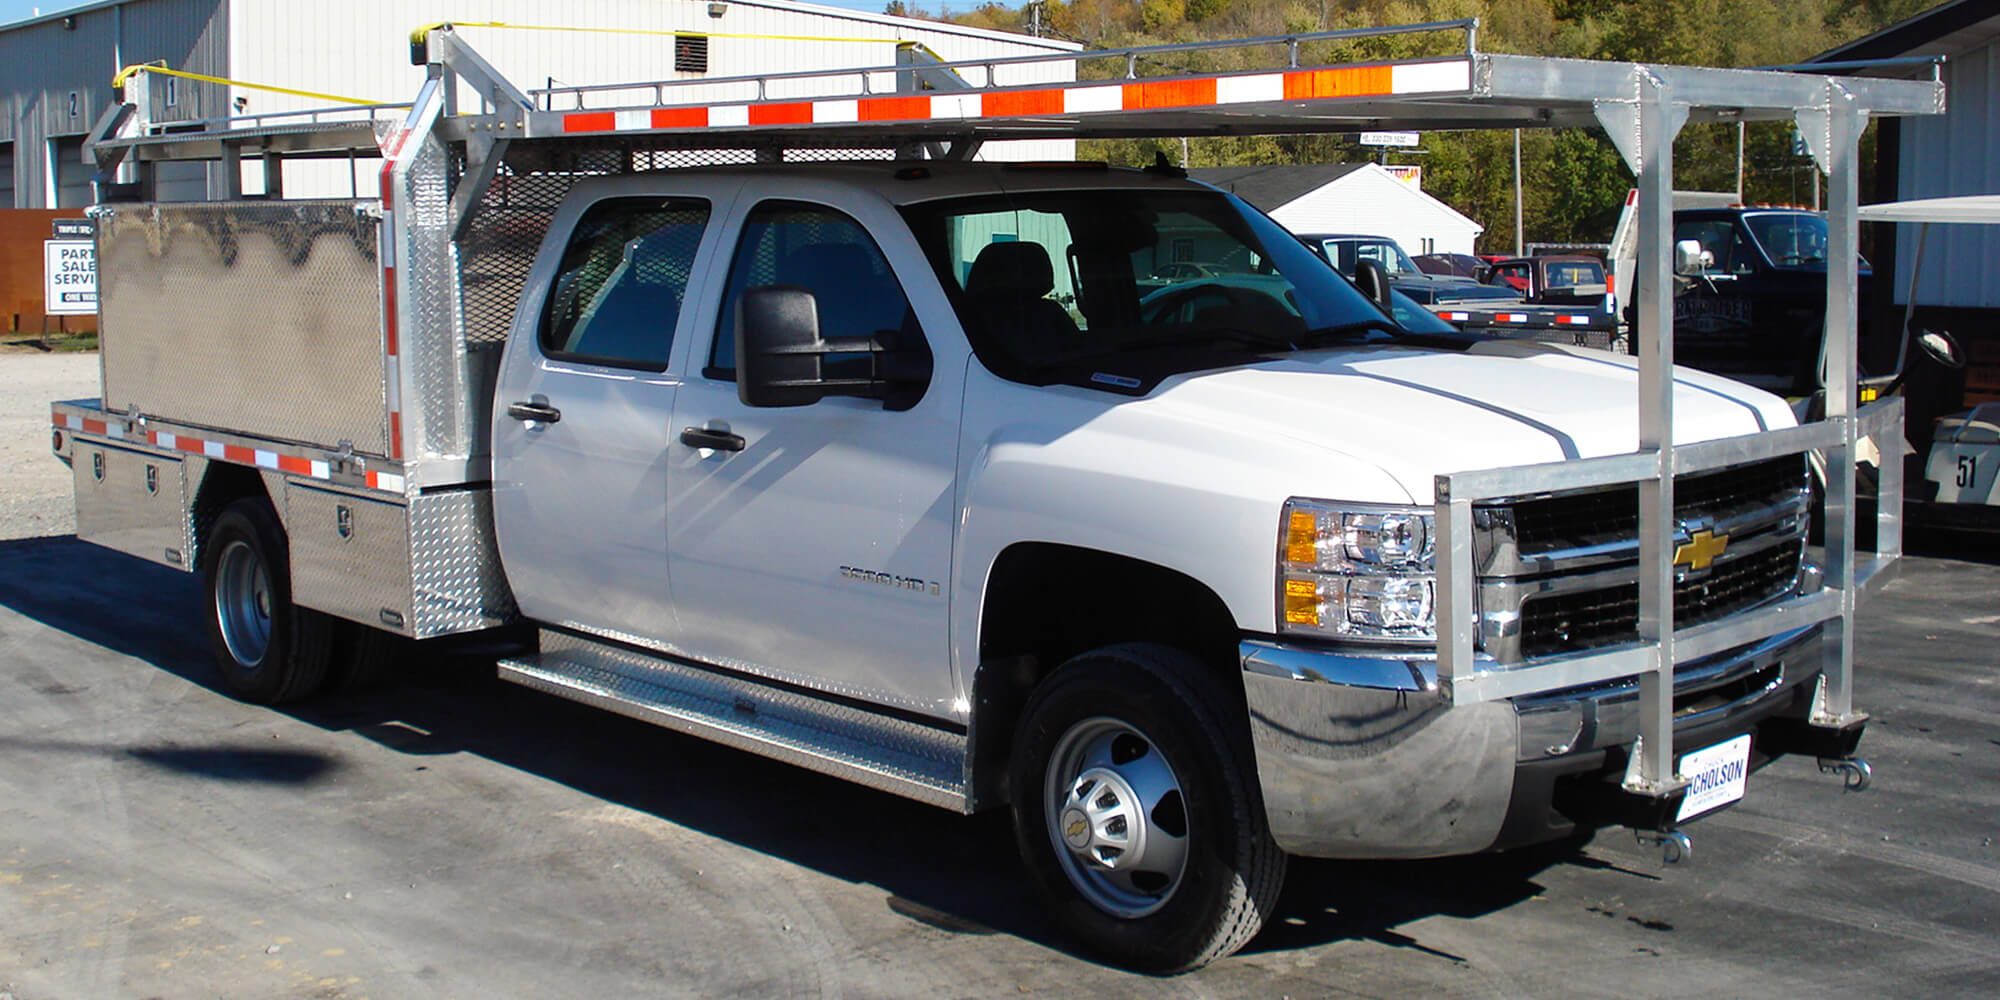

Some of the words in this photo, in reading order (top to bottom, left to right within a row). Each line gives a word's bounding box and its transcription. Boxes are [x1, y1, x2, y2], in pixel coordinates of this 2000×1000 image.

[69, 91, 77, 116] 2
[61, 249, 96, 260] PART
[61, 261, 97, 272] SALE
[54, 273, 95, 285] SERVI
[1956, 455, 1977, 489] 51
[1686, 758, 1744, 797] ICHOLSON
